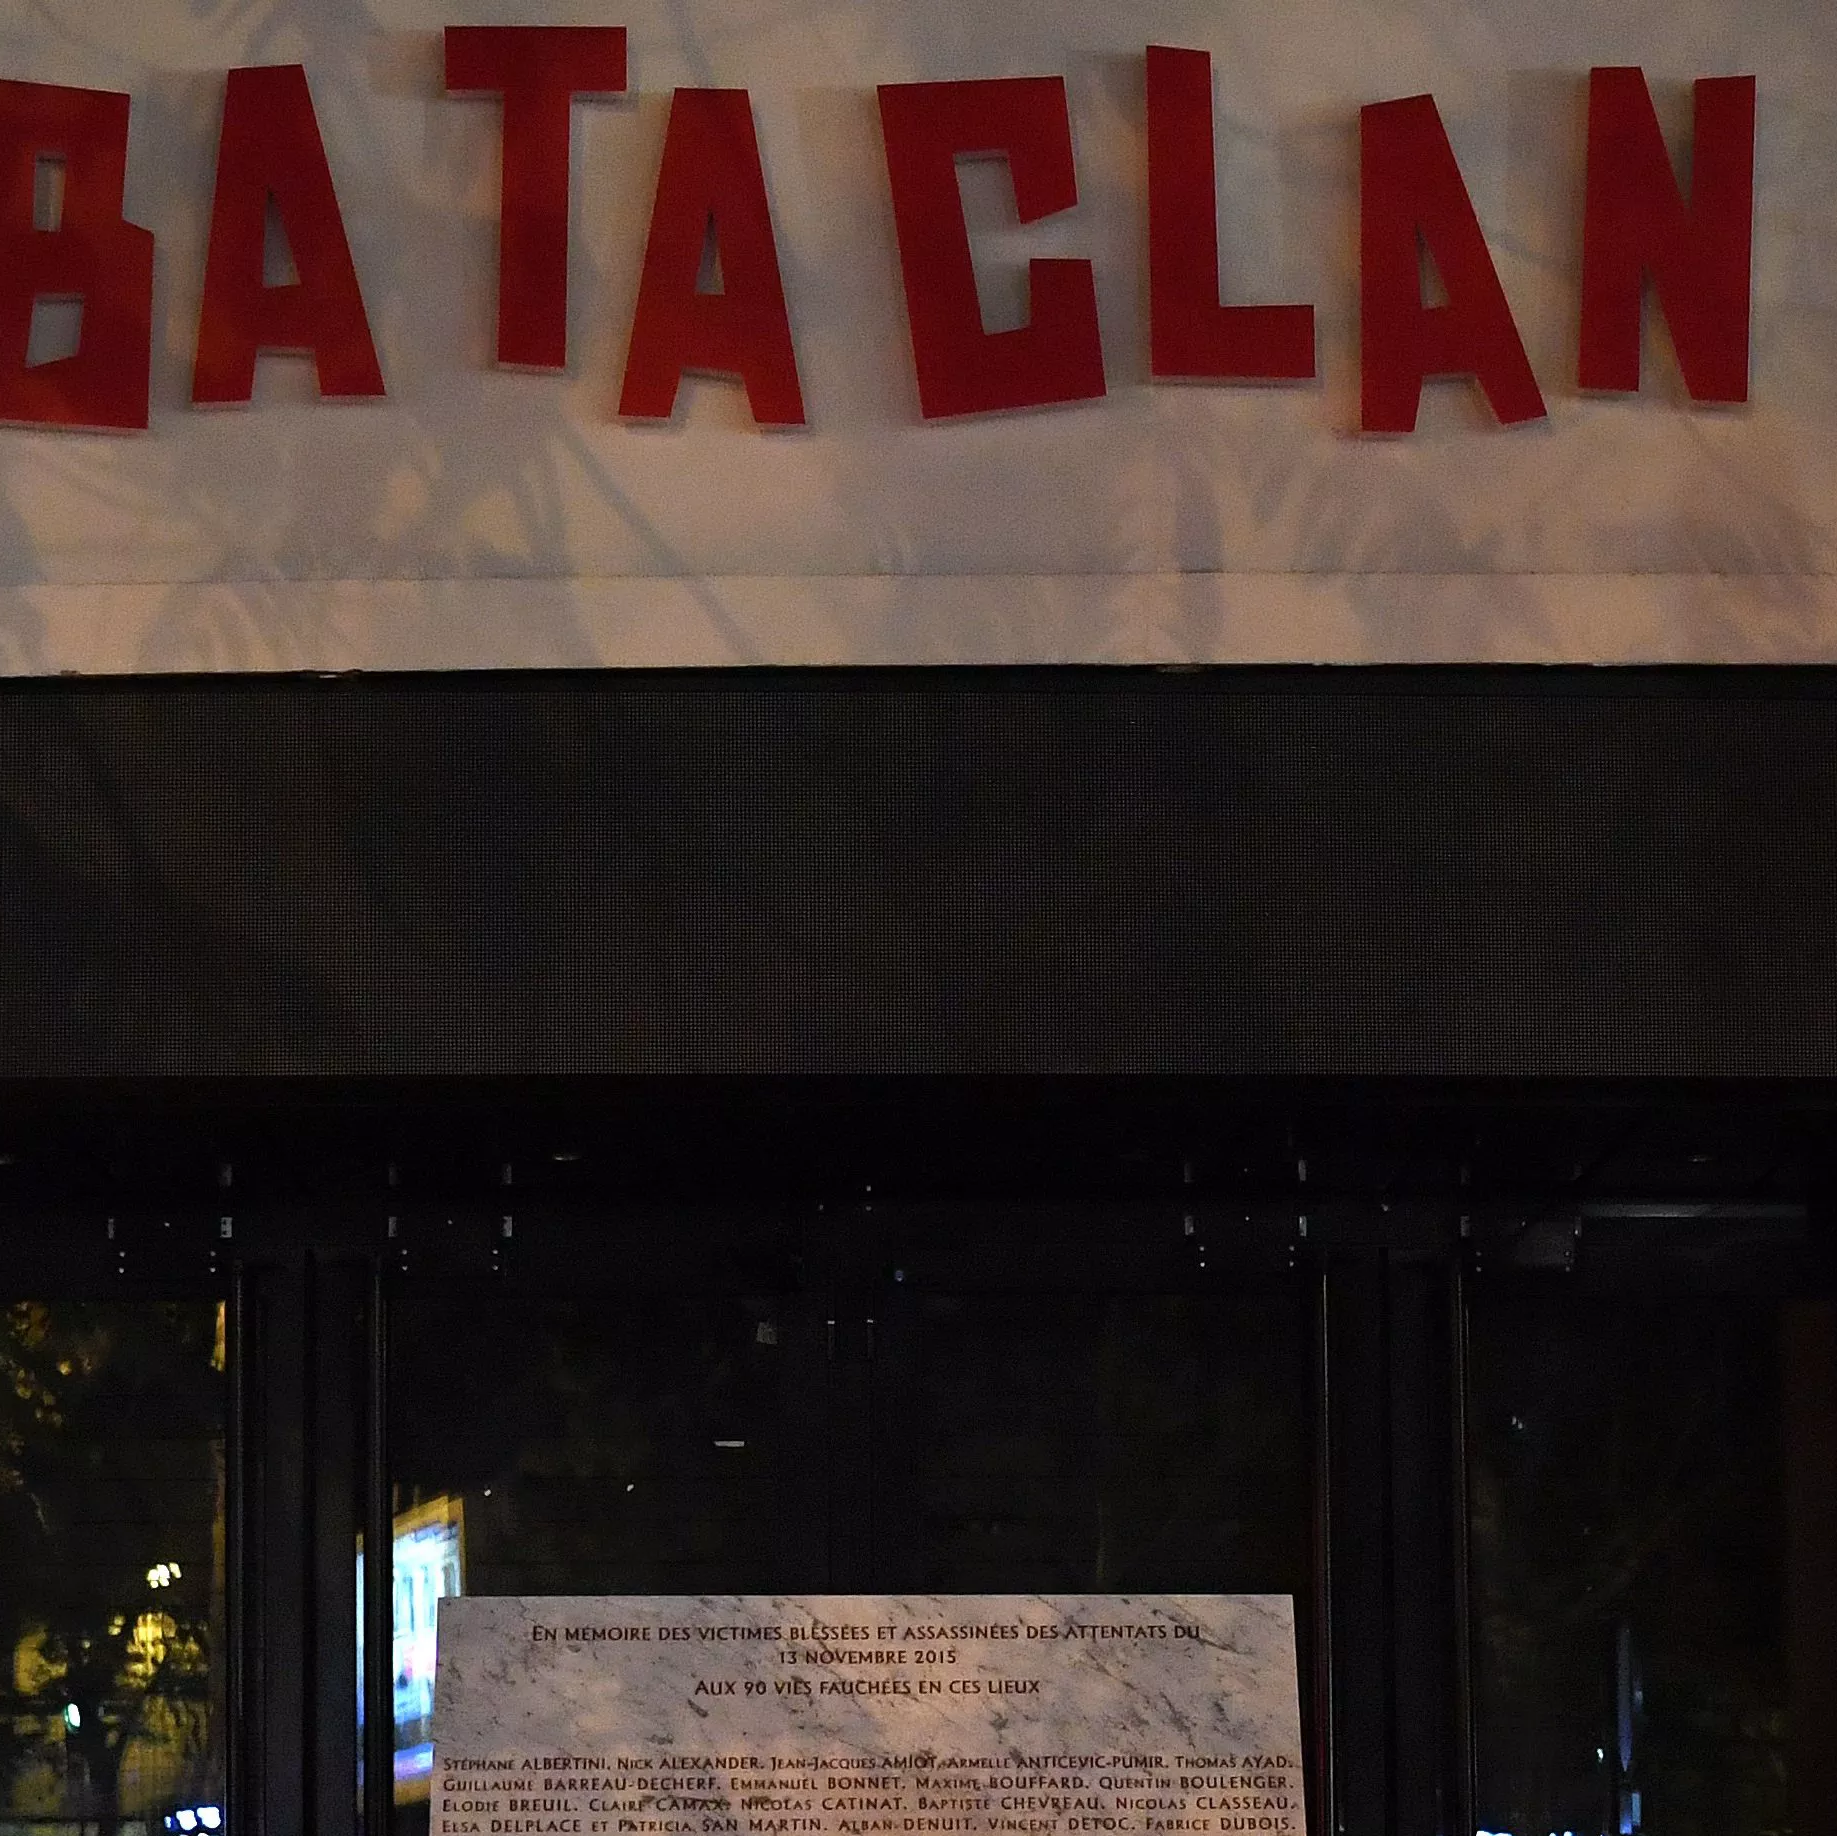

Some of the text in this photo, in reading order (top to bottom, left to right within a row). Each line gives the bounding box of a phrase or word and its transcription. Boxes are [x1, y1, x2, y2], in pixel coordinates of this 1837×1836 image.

[779, 1650, 956, 1665] 13 NOVEMBRE 2015
[744, 1681, 767, 1696] 90
